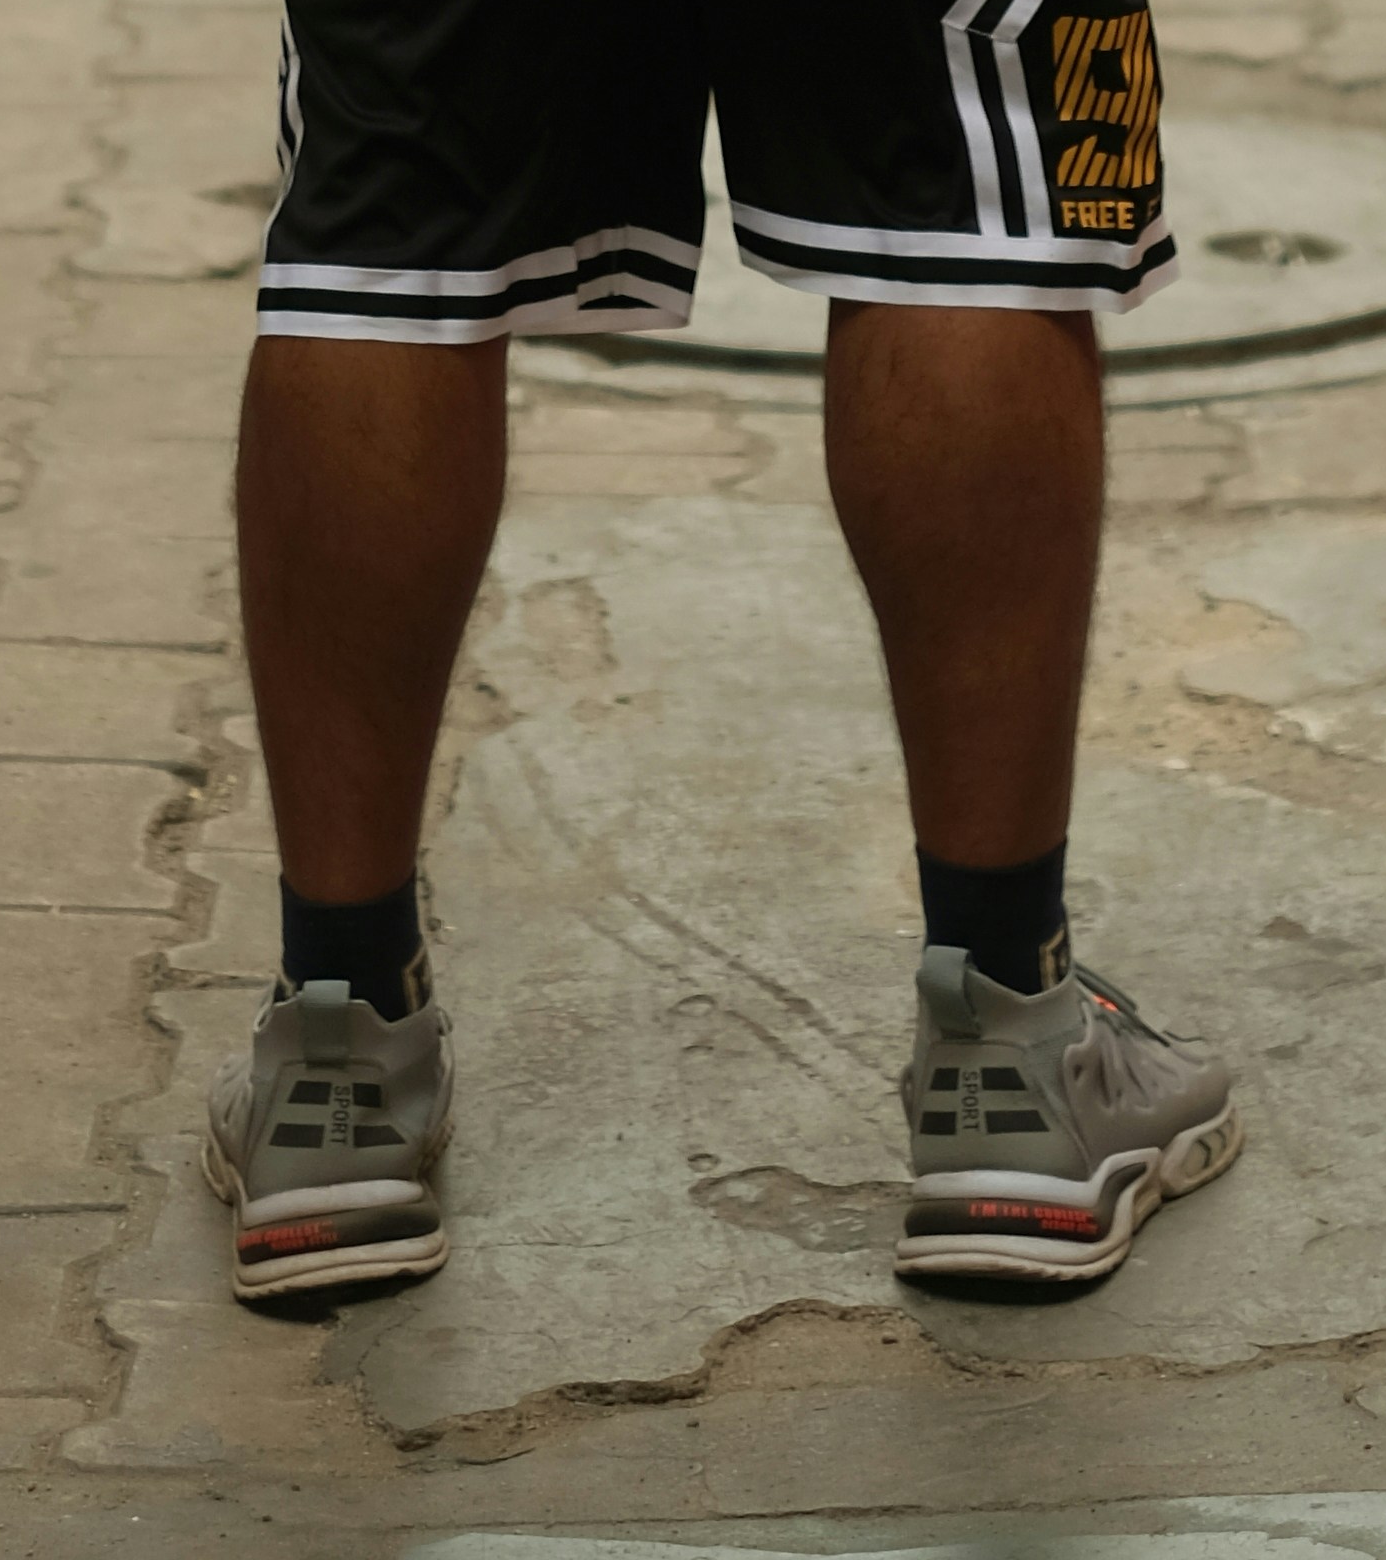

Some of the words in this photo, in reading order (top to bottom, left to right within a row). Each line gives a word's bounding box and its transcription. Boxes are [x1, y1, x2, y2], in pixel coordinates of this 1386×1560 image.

[1060, 200, 1135, 230] FREE
[330, 1085, 351, 1145] SPORT
[961, 1070, 980, 1131] SPORT
